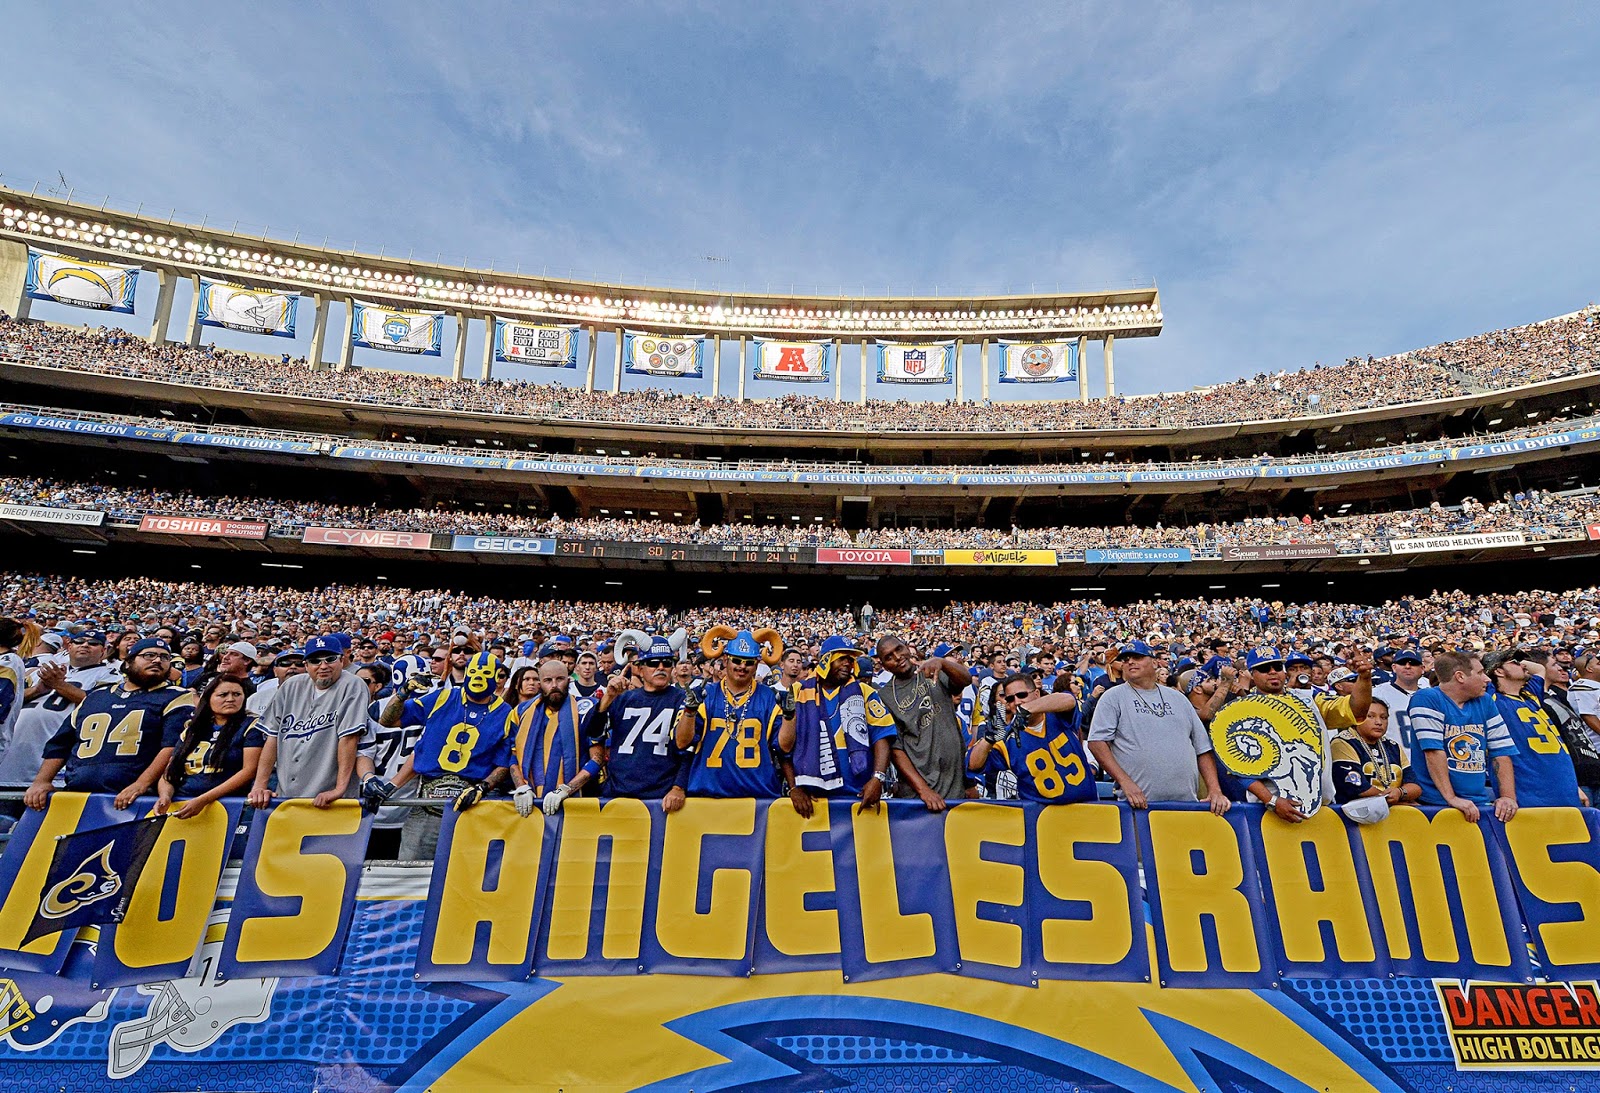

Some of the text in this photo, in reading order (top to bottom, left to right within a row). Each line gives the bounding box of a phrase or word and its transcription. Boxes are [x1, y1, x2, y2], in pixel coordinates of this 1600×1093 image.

[387, 324, 405, 336] 50
[514, 327, 533, 336] 2004
[514, 337, 532, 346] 2007
[526, 348, 545, 357] 2009
[906, 360, 924, 374] NFL
[13, 416, 31, 425] 86
[36, 417, 71, 430] EARL
[74, 422, 127, 435] FAISON
[211, 436, 241, 446] DAN
[242, 439, 283, 450] FOUTS
[1470, 447, 1485, 456] 22
[1490, 442, 1524, 454] GILL
[1525, 434, 1571, 449] BYRD
[370, 450, 420, 462] CHARLIE
[421, 454, 465, 465] JOINER
[522, 461, 548, 470] DON
[549, 463, 596, 473] CORYELL
[1275, 467, 1283, 475] 6
[1288, 466, 1317, 475] ROLF
[1319, 457, 1403, 473] BENIRSCHKE
[666, 469, 707, 479] SPEEDY
[709, 471, 755, 480] DUNCAN
[823, 474, 860, 482] KELLEN
[862, 474, 915, 483] WINSLOW
[982, 475, 1011, 483] RUSS
[1012, 474, 1087, 483] WASHINGTON
[1140, 468, 1254, 481] GEORGE PERNICANO
[2, 507, 100, 522] DIEGO HEALTH SYSTEM
[147, 518, 222, 533] TOSHIBA
[226, 523, 266, 531] DOCUMENT
[323, 530, 414, 546] CYMER
[473, 537, 541, 551] GEICO
[1407, 541, 1425, 550] SAN
[1427, 539, 1450, 548] DIEGO
[1451, 537, 1484, 547] HEALTH
[1485, 534, 1521, 544] SYSTEM
[562, 542, 585, 553] STL
[592, 546, 605, 557] 17
[648, 546, 663, 556] SD
[1265, 549, 1285, 557] please
[671, 550, 685, 560] 27
[746, 552, 757, 562] 10
[767, 552, 780, 562] 24
[837, 551, 892, 561] TOYOTA
[1107, 550, 1143, 562] Brigantine
[315, 637, 326, 648] LA
[1133, 699, 1172, 710] RMS
[77, 710, 145, 759] 94
[618, 706, 675, 756] 74
[437, 722, 480, 773] 8
[706, 718, 762, 769] 78
[1025, 731, 1086, 799] 85
[431, 797, 1133, 968] ANGELES
[1149, 805, 1600, 973] RAMS
[1444, 988, 1600, 1027] DANGER
[1457, 1036, 1600, 1060] HIGH BOLTAG
